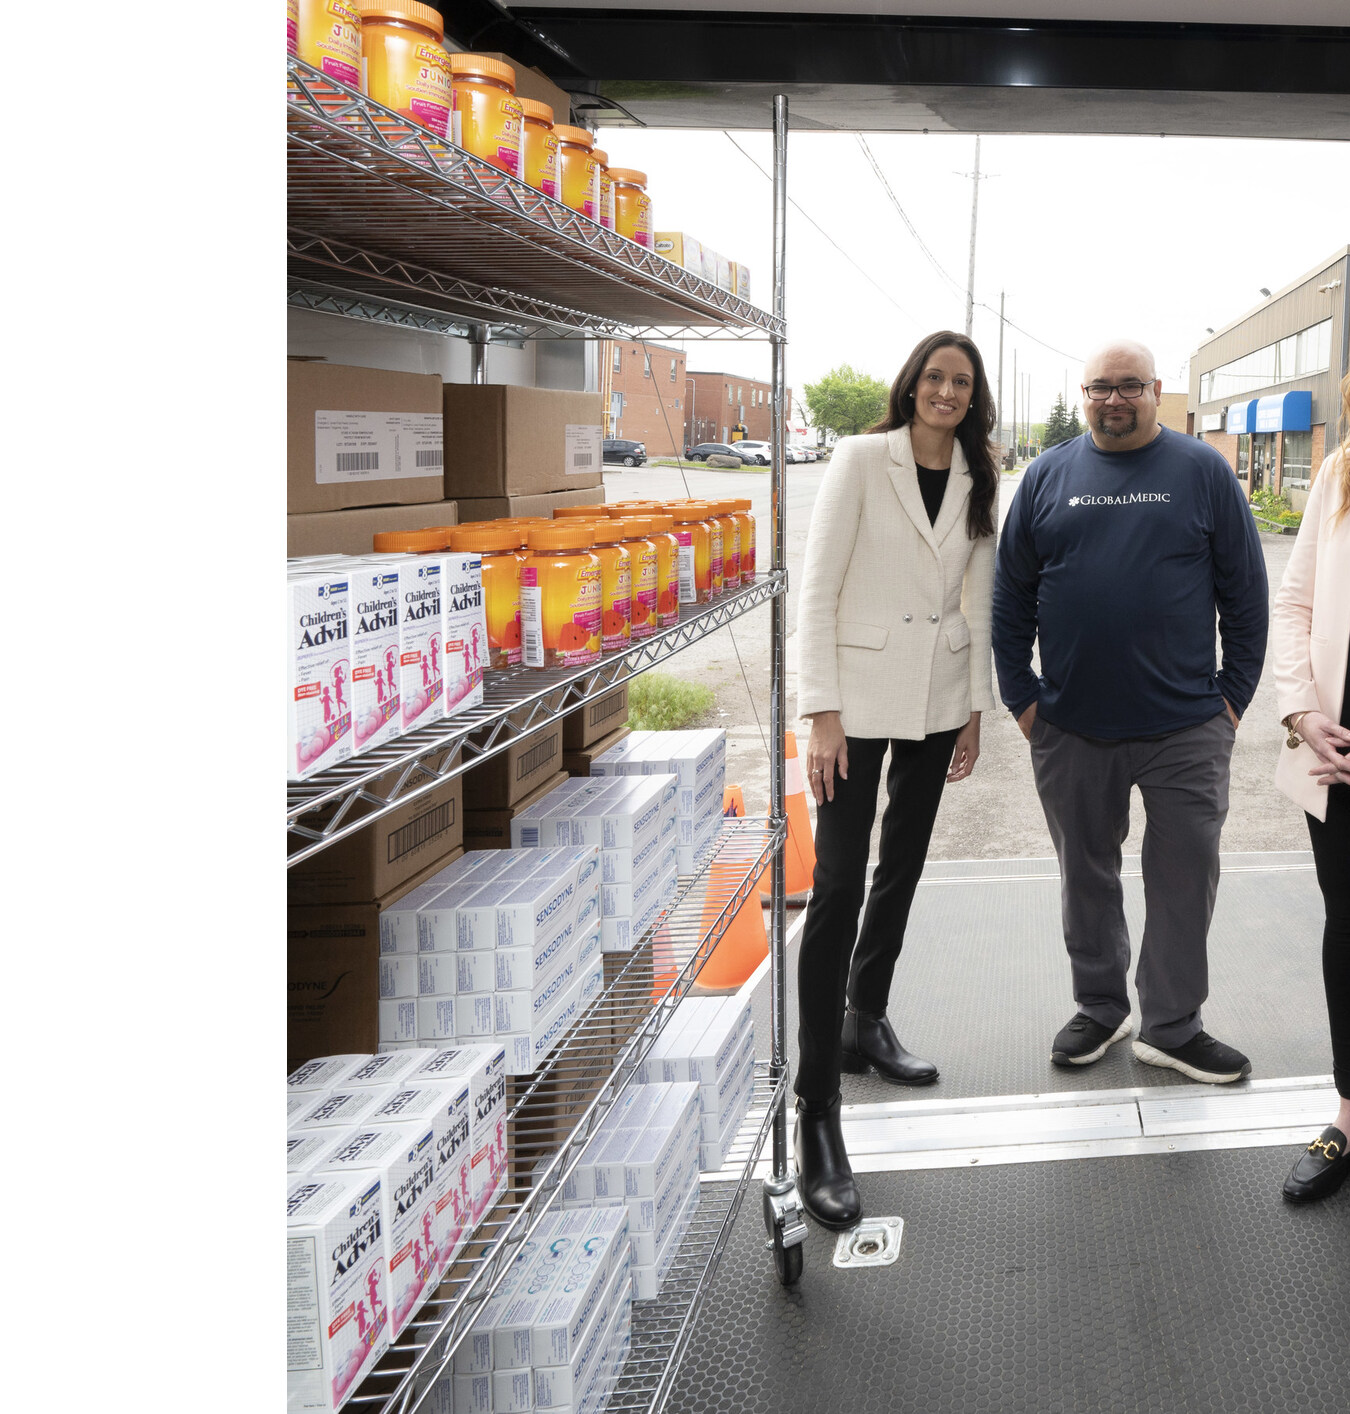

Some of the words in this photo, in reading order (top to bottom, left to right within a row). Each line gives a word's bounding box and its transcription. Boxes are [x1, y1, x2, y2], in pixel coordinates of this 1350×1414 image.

[357, 596, 397, 614] Children's
[403, 598, 440, 622] Advil
[405, 587, 440, 603] Children's
[448, 590, 481, 613] Advil
[450, 581, 481, 595] Children's
[297, 619, 348, 650] Advil
[300, 607, 347, 627] Children's
[355, 608, 397, 635] Advil
[535, 883, 574, 927] SENSODYNE
[535, 923, 573, 970] SENSODYNE
[533, 962, 574, 1013] SENSODYNE
[535, 1001, 576, 1055] SENSODYNE
[473, 1081, 505, 1128] Advil
[435, 1120, 470, 1173] Advil
[437, 1112, 469, 1151] Children's
[392, 1164, 434, 1225] Advil
[394, 1157, 433, 1202] Children's
[330, 1219, 381, 1287] Advil
[332, 1209, 380, 1261] Children's
